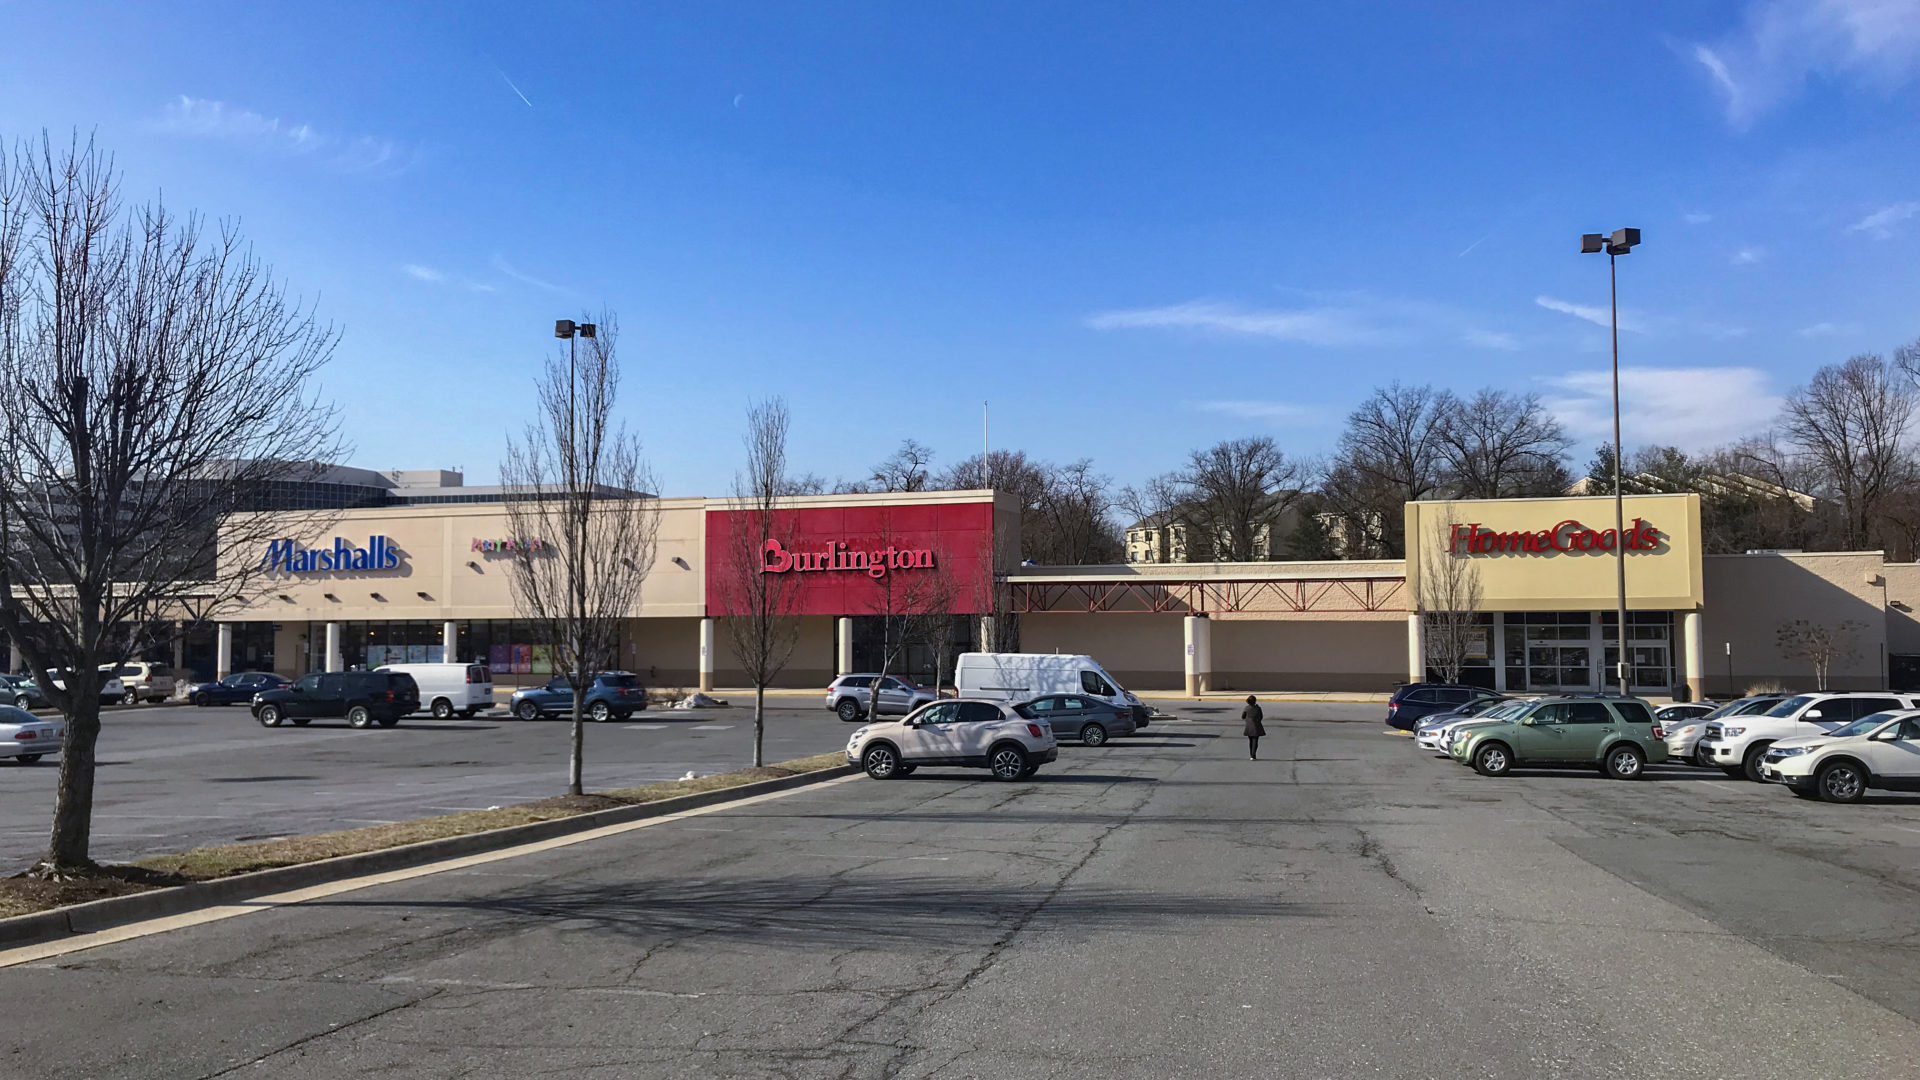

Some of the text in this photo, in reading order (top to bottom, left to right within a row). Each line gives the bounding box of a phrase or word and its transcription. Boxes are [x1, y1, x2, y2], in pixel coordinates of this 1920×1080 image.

[257, 535, 399, 571] Marshalls
[1446, 517, 1658, 553] HomeGoods
[759, 538, 934, 578] Burlington
